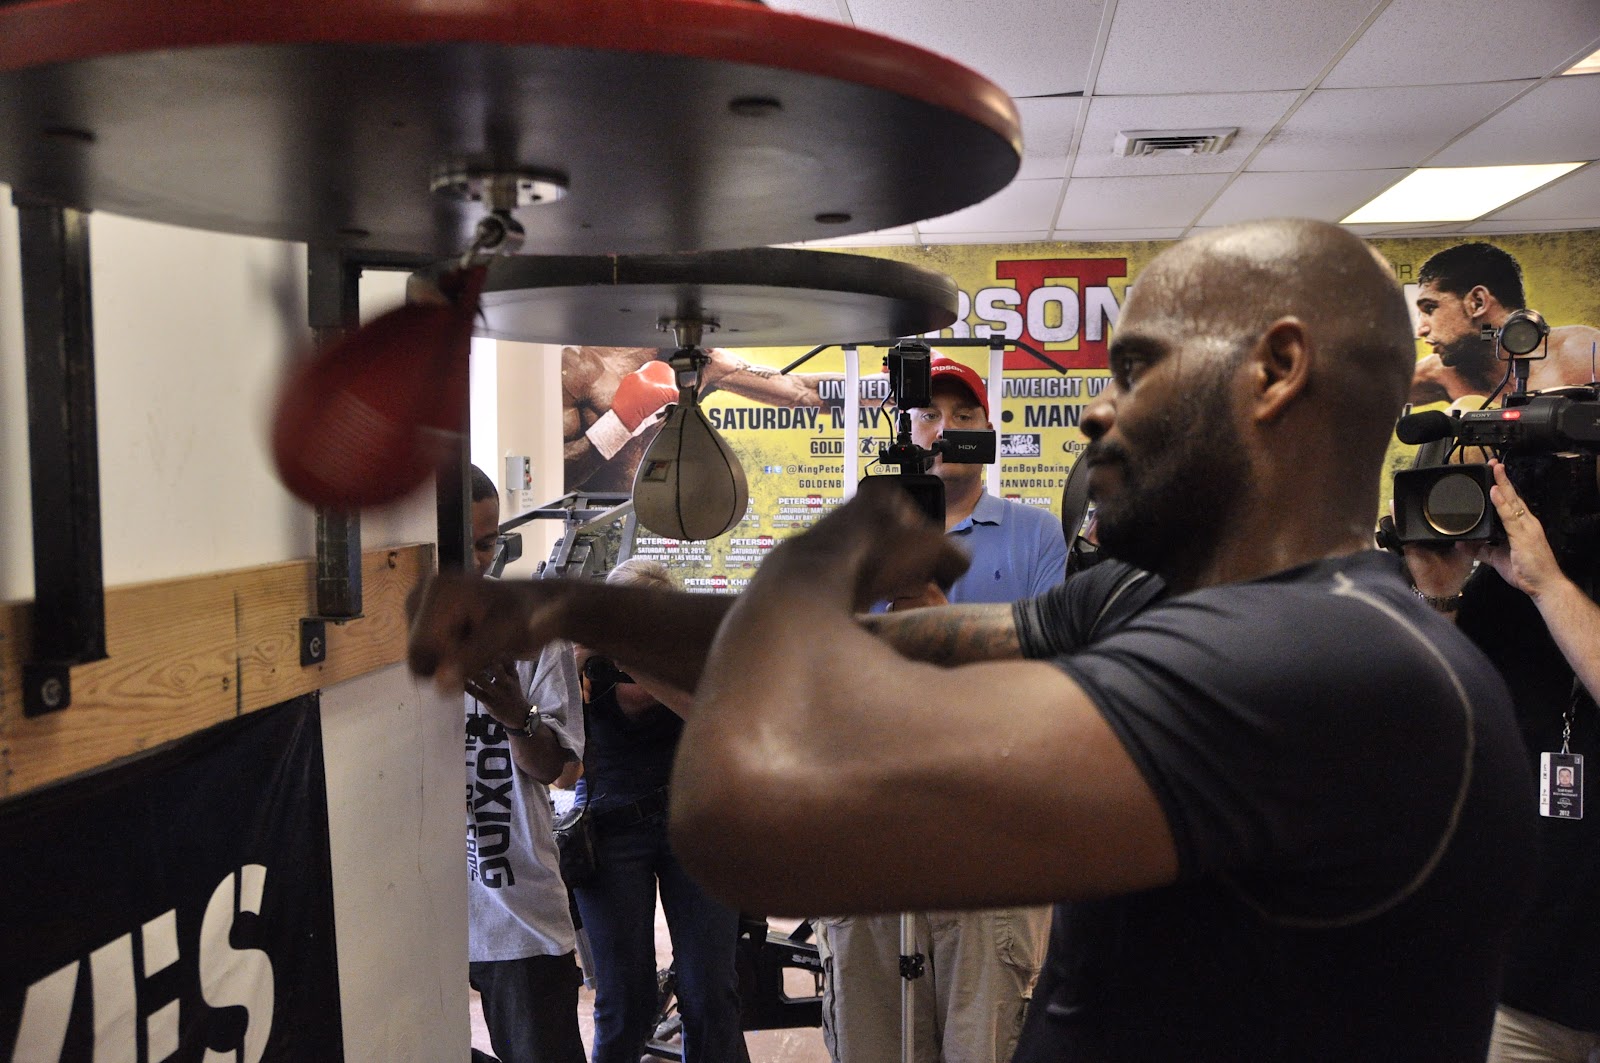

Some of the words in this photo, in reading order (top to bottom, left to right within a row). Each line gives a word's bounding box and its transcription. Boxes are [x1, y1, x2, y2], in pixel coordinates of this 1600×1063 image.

[931, 364, 964, 373] mpson
[1001, 378, 1082, 398] TWEIGHT
[708, 407, 824, 434] SATURDAY,
[1025, 404, 1088, 427] MAN
[810, 441, 844, 455] GOLD
[873, 464, 900, 475] @Am
[1001, 463, 1070, 474] denBoyBoxing
[636, 537, 680, 545] PETERSON
